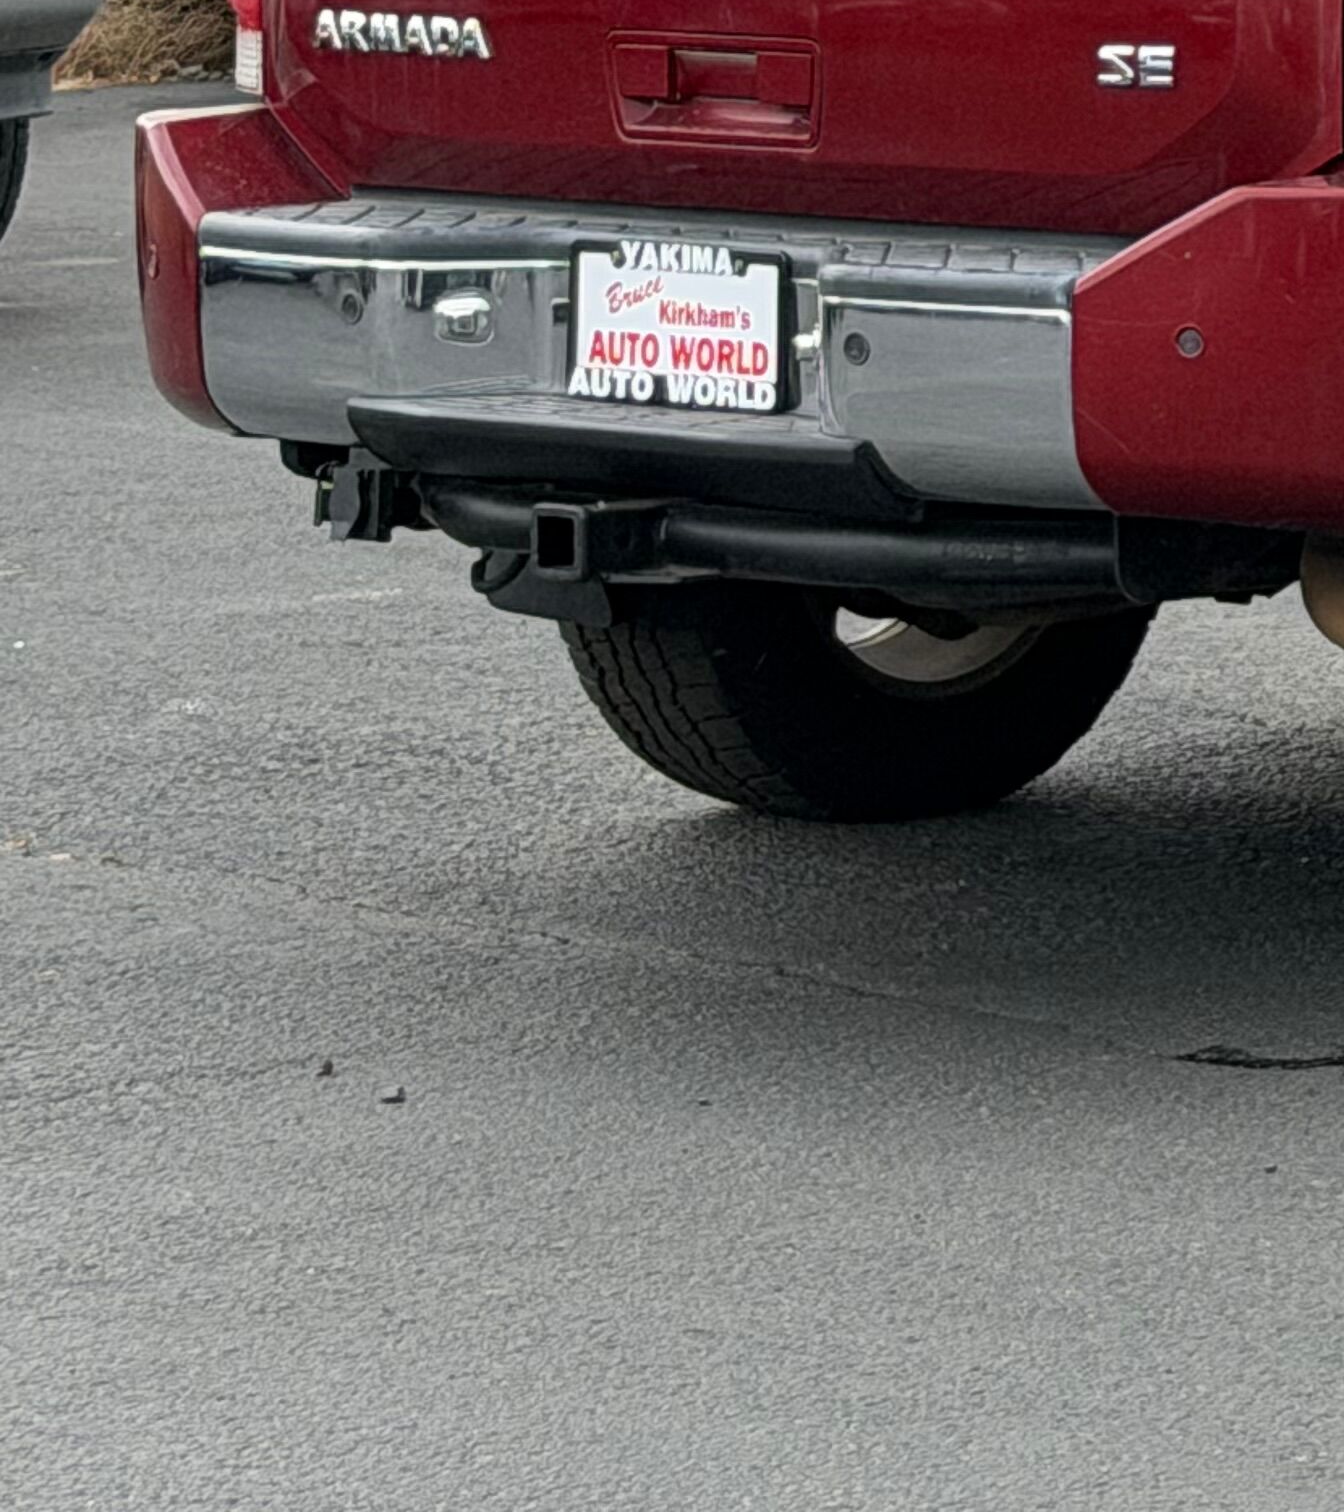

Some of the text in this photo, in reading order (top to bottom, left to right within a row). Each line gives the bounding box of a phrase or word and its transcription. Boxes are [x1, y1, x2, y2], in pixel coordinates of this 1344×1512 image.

[313, 8, 493, 60] ARMADA
[1097, 44, 1176, 87] SE
[620, 240, 734, 276] YAKIMA
[659, 299, 751, 330] Kirkham's
[588, 330, 769, 376] AUTO WORLD
[568, 367, 777, 411] AUTO WORLD
